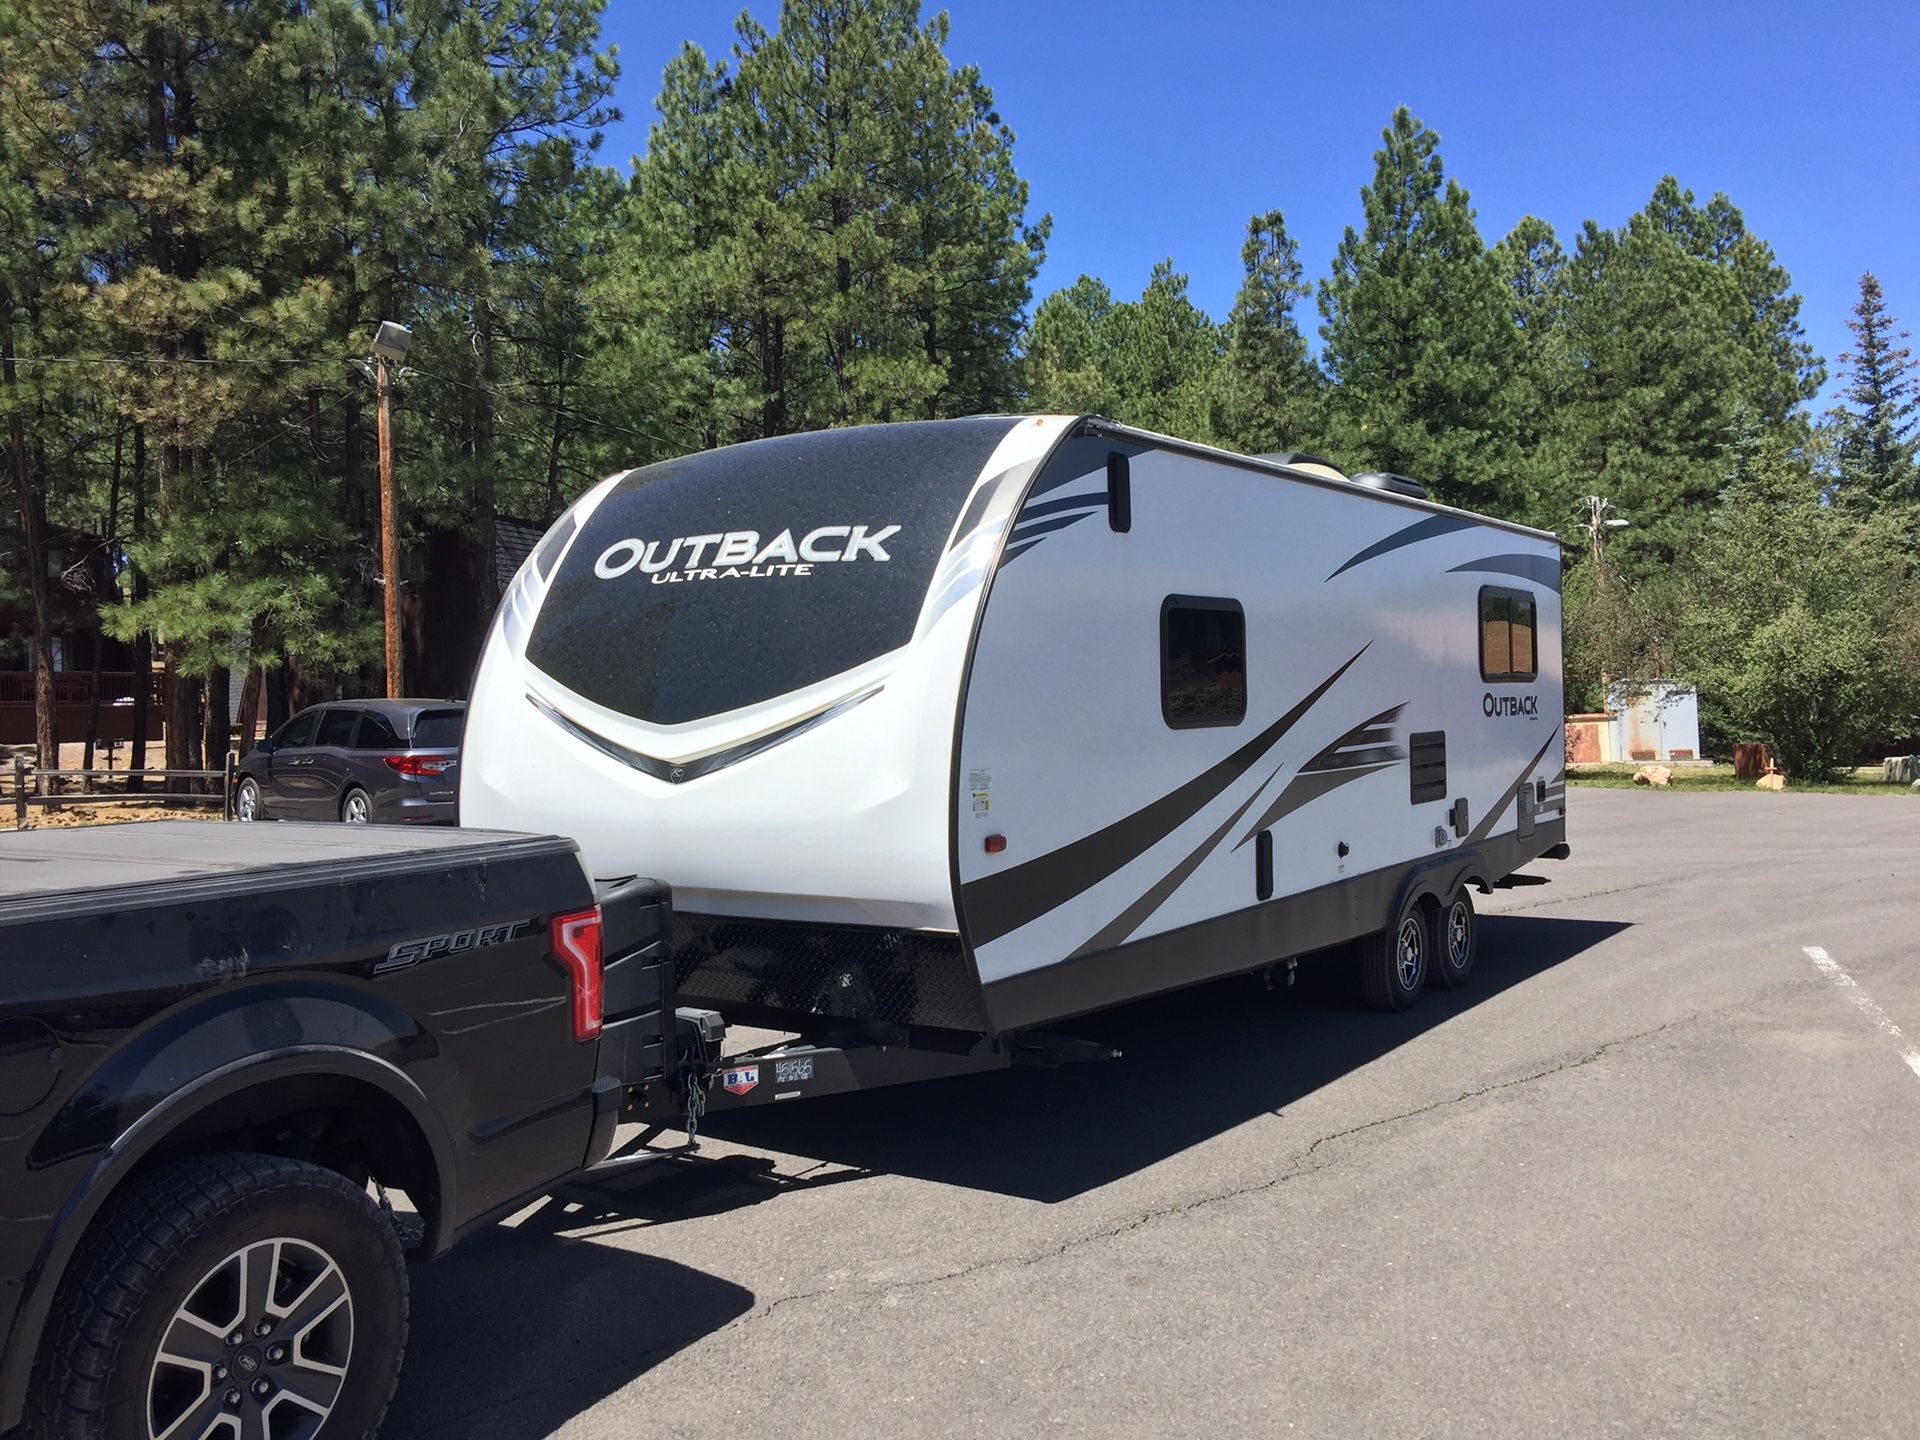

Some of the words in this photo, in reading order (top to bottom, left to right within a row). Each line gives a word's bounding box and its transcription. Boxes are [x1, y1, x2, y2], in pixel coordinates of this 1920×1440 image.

[593, 525, 902, 580] OUTBACK
[651, 563, 815, 585] ULTRA-LITE
[1482, 692, 1538, 718] OUTBACK
[373, 919, 532, 974] SPORT
